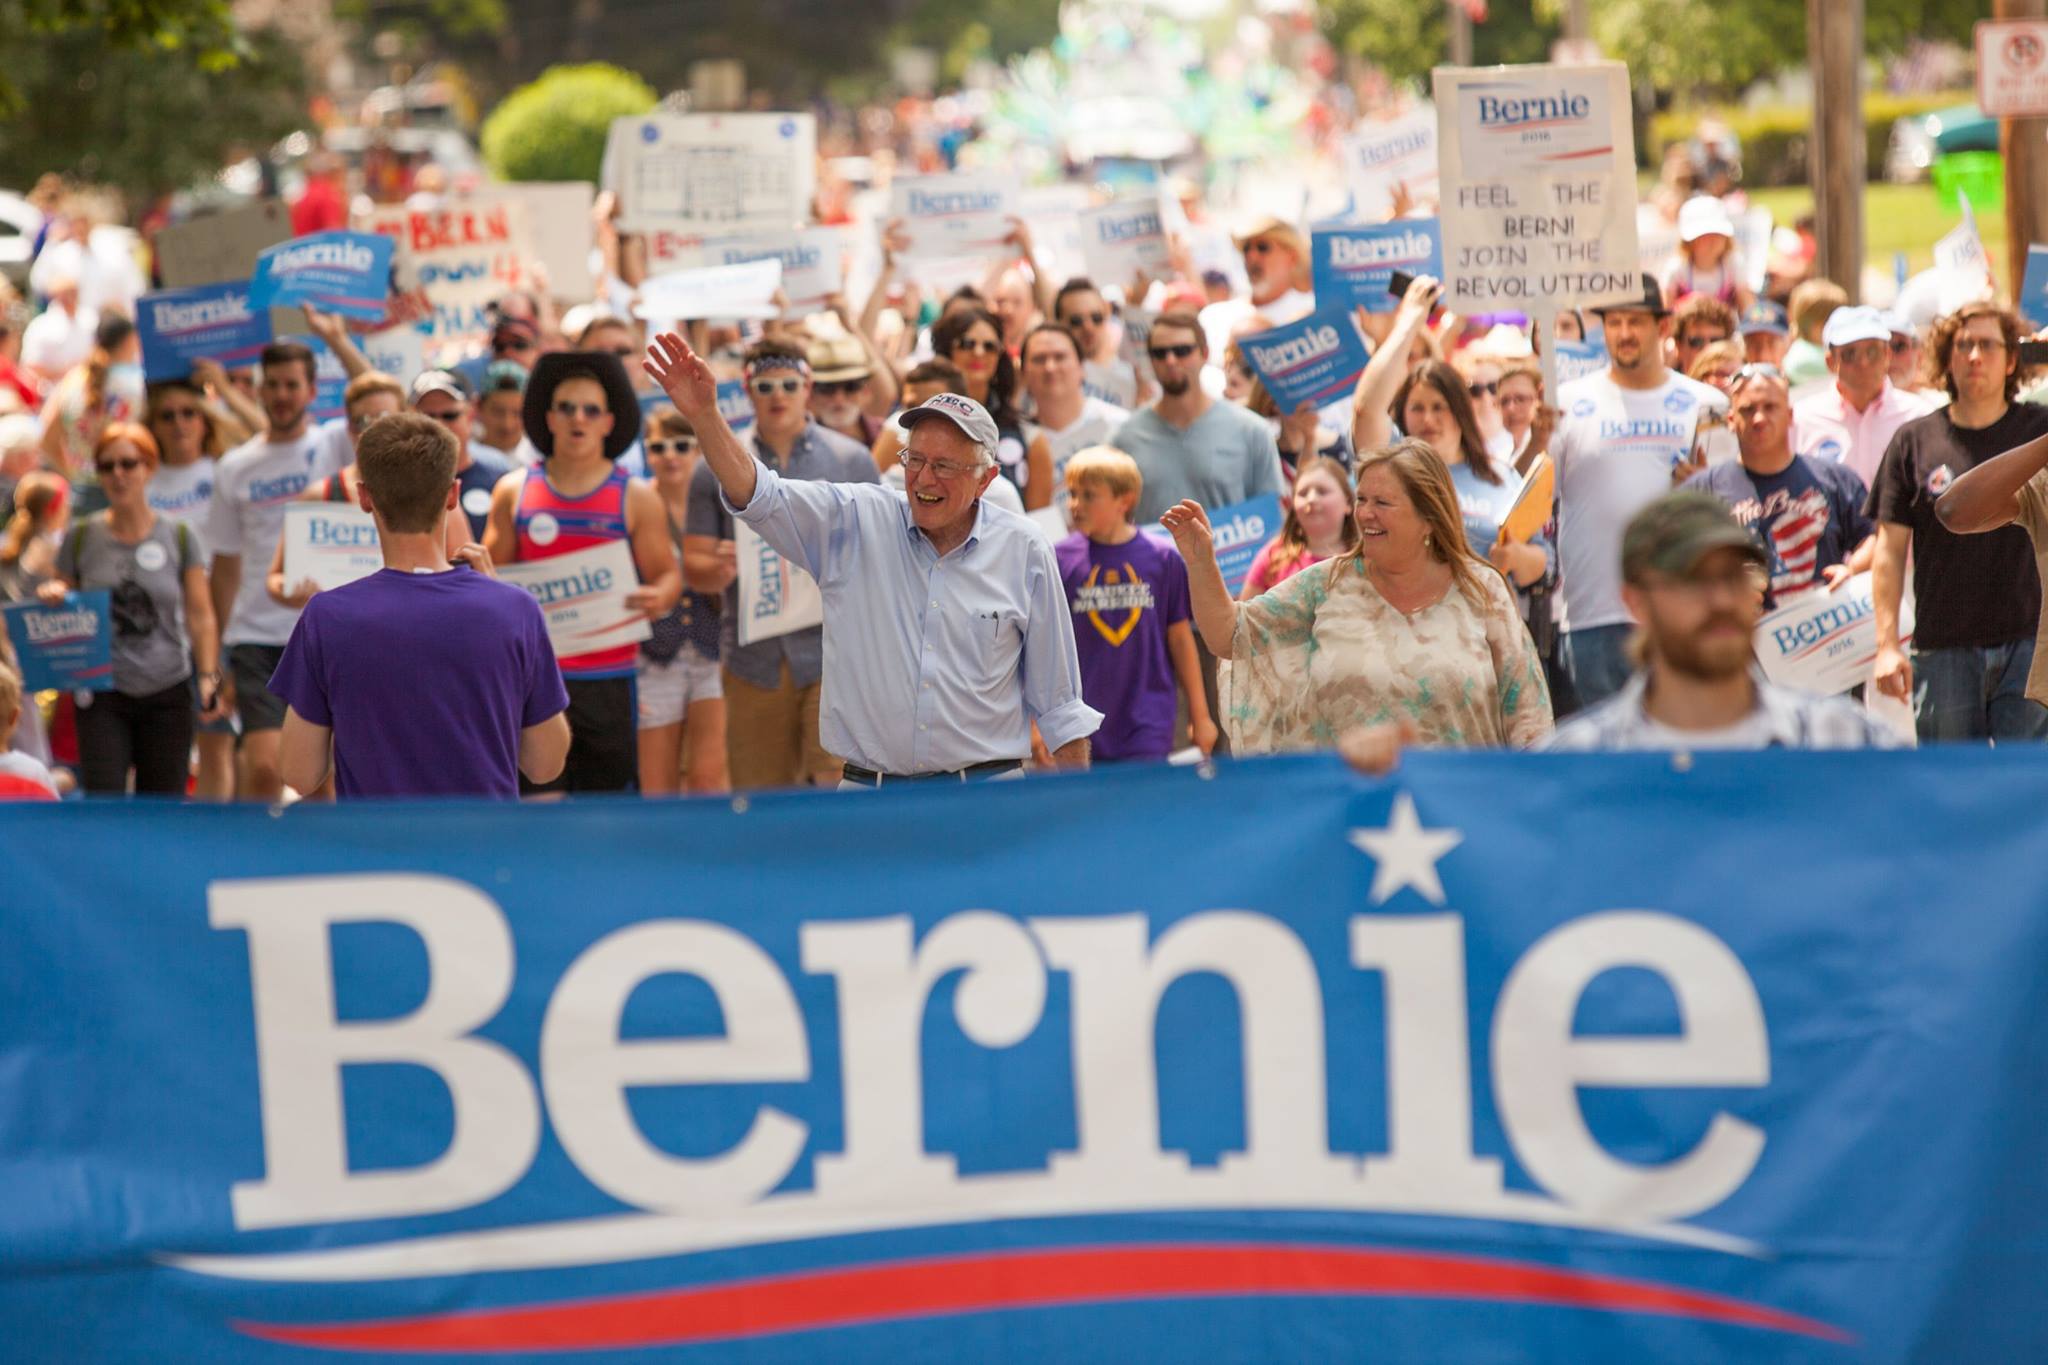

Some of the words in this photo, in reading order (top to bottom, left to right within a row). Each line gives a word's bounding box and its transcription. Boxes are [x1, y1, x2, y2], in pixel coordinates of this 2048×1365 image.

[1479, 89, 1590, 125] Bernie
[1459, 184, 1518, 209] FEEL
[1552, 181, 1600, 204] THE
[1505, 215, 1575, 239] BERN!
[1329, 229, 1433, 267] Bernie
[1458, 244, 1528, 269] JOIN
[1552, 239, 1600, 263] THE
[1251, 325, 1340, 373] Bernie
[1600, 418, 1685, 438] Bernie
[309, 518, 378, 545] Bern
[1213, 513, 1265, 550] nie
[754, 537, 781, 619] Bern
[22, 604, 98, 640] Bernie
[206, 792, 1771, 1232] Bernie
